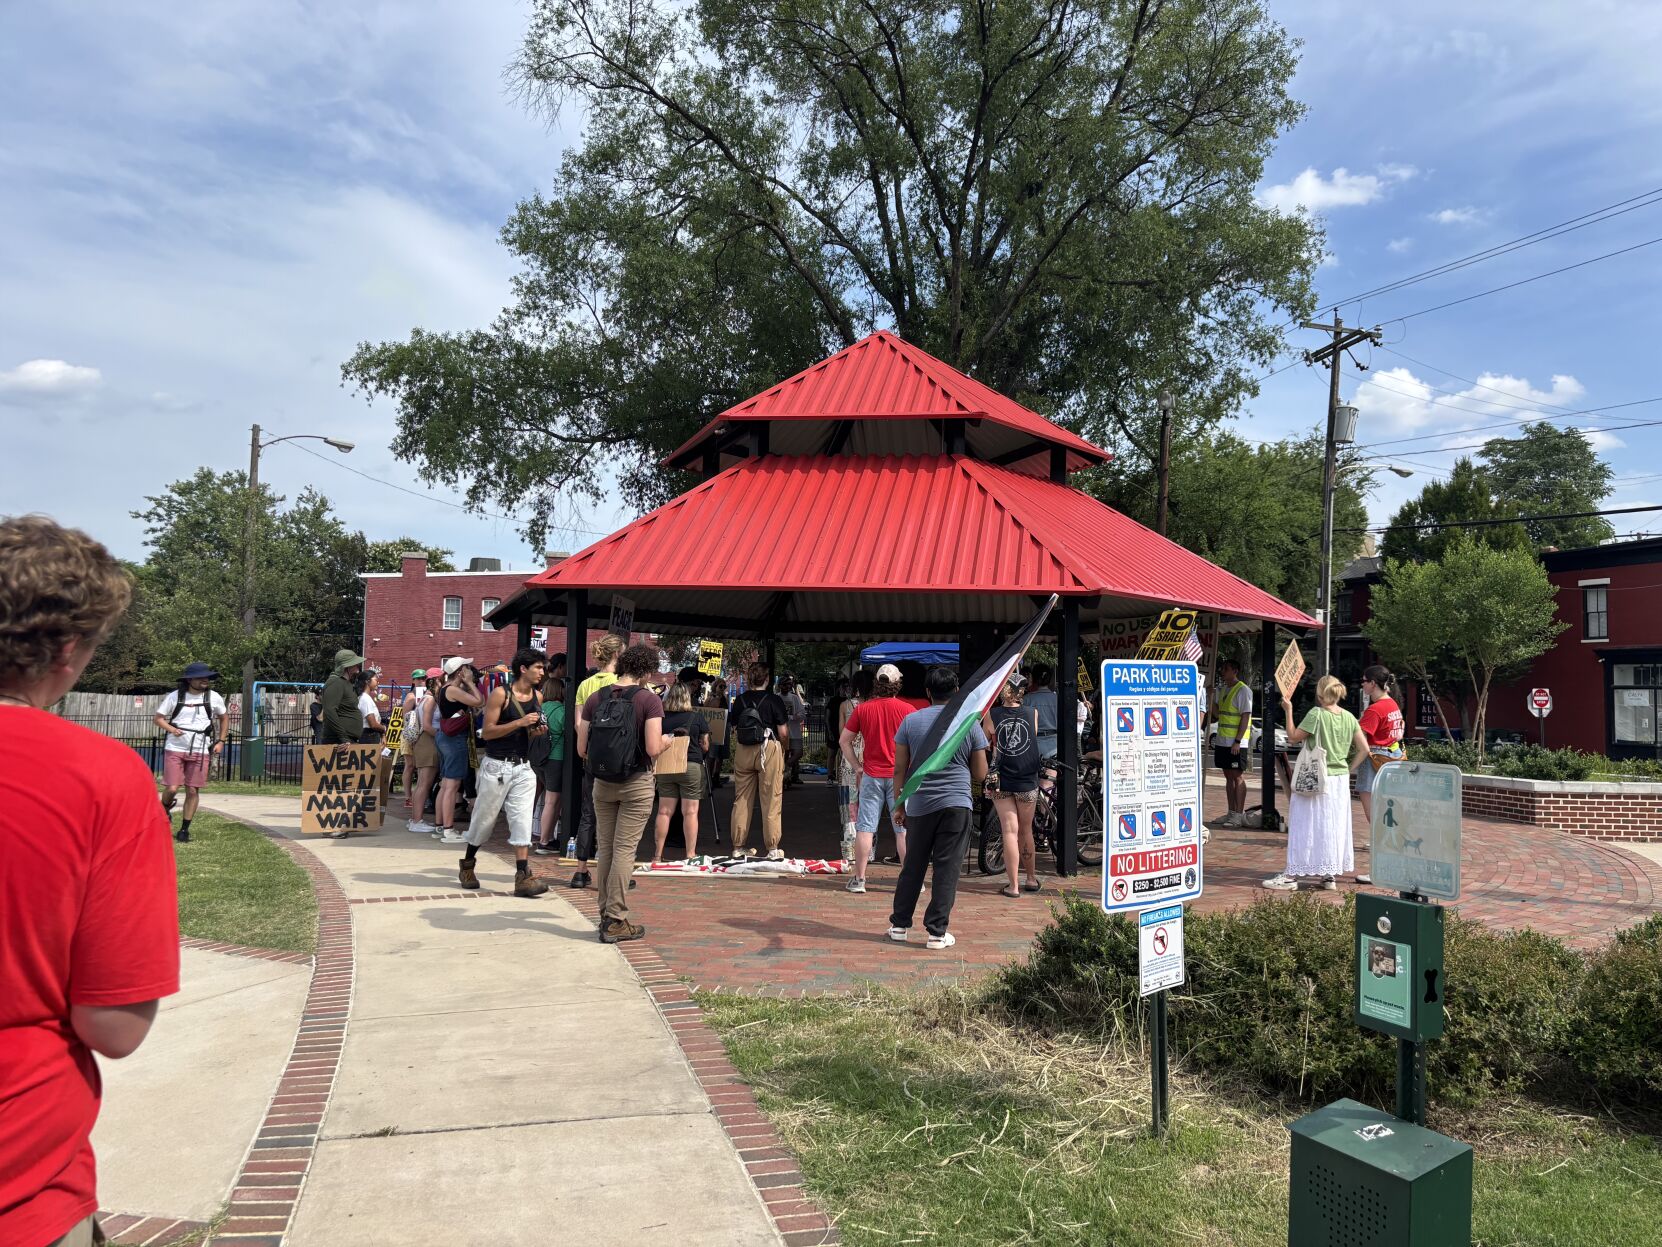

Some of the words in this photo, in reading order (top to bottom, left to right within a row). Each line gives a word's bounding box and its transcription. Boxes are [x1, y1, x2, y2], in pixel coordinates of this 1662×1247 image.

[1103, 620, 1126, 636] NO
[1159, 613, 1194, 631] NO
[1101, 634, 1139, 651] WAR
[1112, 667, 1150, 684] PARK
[1151, 668, 1190, 684] RULES
[307, 746, 377, 774] WEAK
[316, 773, 376, 795] MEN
[306, 794, 377, 813] MAKE
[315, 812, 369, 830] WAR
[1117, 855, 1135, 874] NO
[1139, 846, 1193, 871] LITTERING
[1134, 880, 1150, 892] $250
[1153, 876, 1169, 889] $2,500
[1169, 873, 1181, 885] FINE
